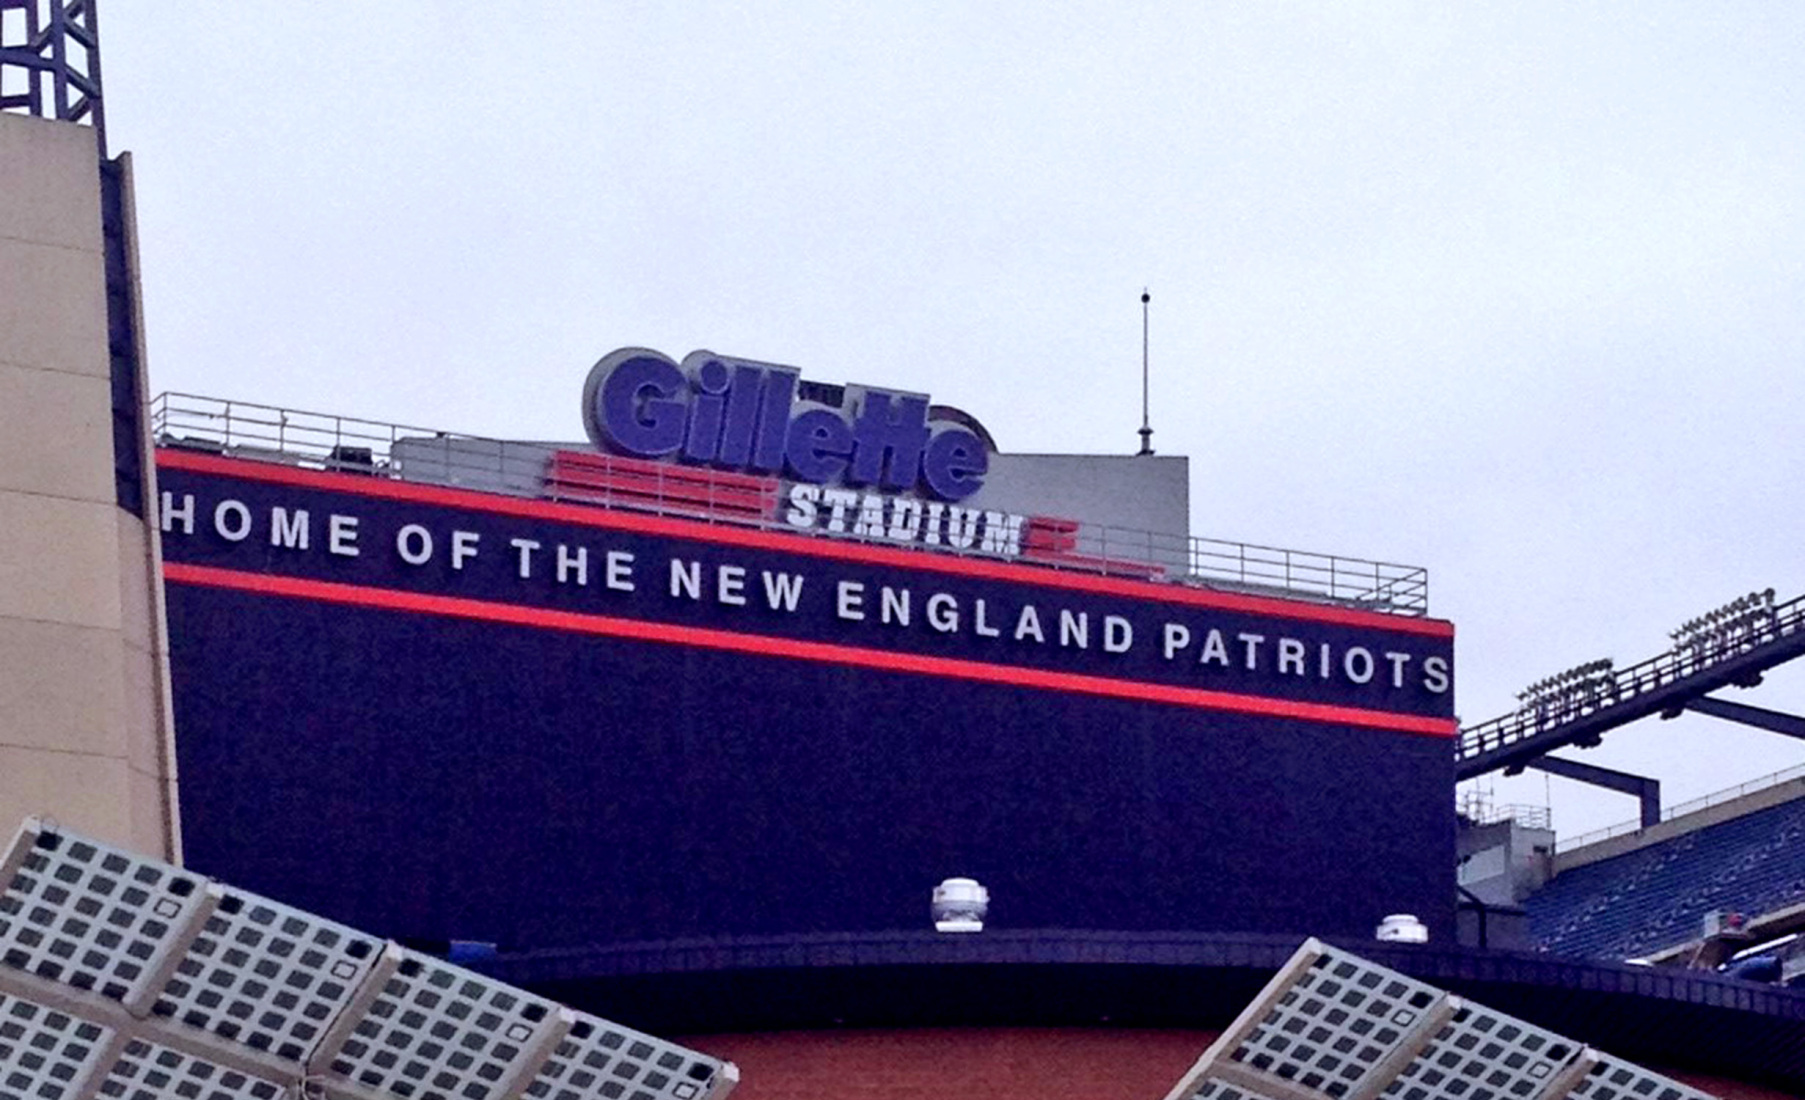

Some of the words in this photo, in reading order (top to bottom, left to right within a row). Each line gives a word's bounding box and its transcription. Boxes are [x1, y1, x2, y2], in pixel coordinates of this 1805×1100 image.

[583, 346, 998, 502] Gillette
[159, 490, 361, 557] HOME
[396, 523, 481, 571] OF
[511, 538, 636, 592] THE
[669, 559, 804, 613] NEW
[836, 581, 1134, 655] ENGLAND
[1164, 623, 1449, 694] PATRIOTS
[787, 482, 1024, 556] STADIUM
